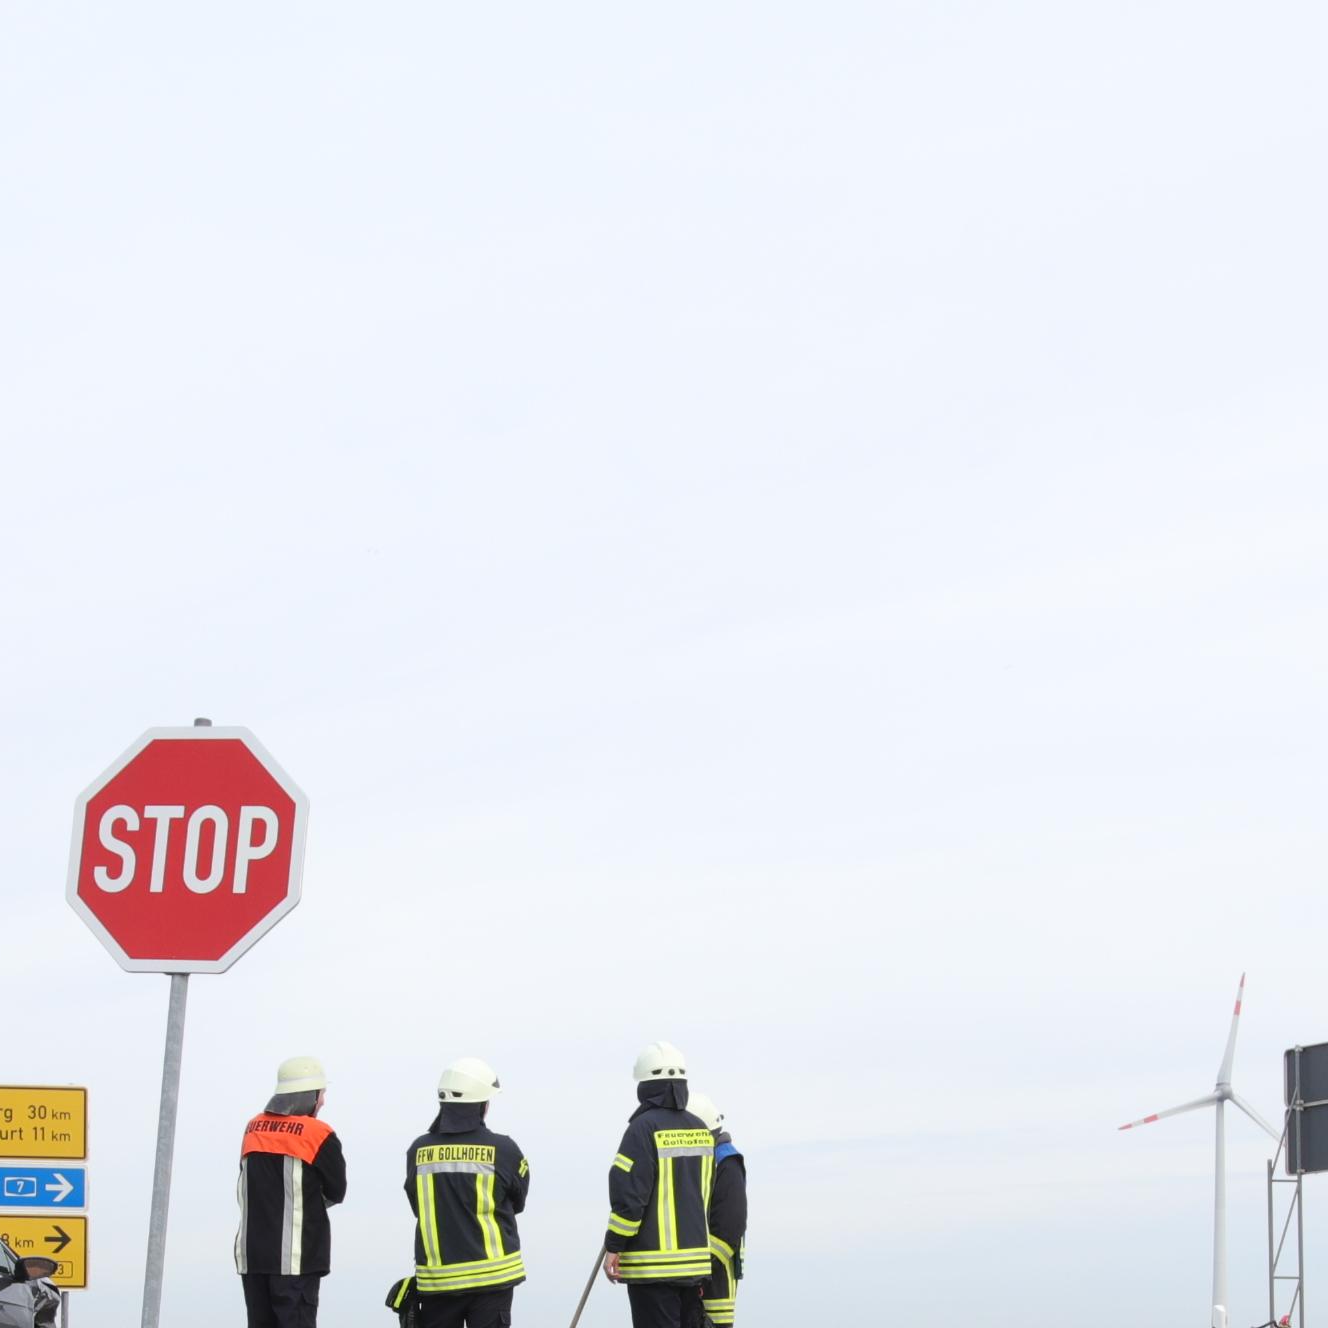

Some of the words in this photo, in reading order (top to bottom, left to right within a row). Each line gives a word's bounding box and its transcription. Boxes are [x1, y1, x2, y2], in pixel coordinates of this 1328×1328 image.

[93, 804, 280, 895] STOP
[27, 1104, 47, 1120] 30
[51, 1108, 71, 1121] km
[32, 1126, 46, 1141] 11
[51, 1130, 71, 1142] km
[417, 1147, 434, 1163] FFW
[438, 1146, 494, 1162] GOLLHOFEN
[16, 1180, 25, 1194] 7
[15, 1237, 34, 1249] km
